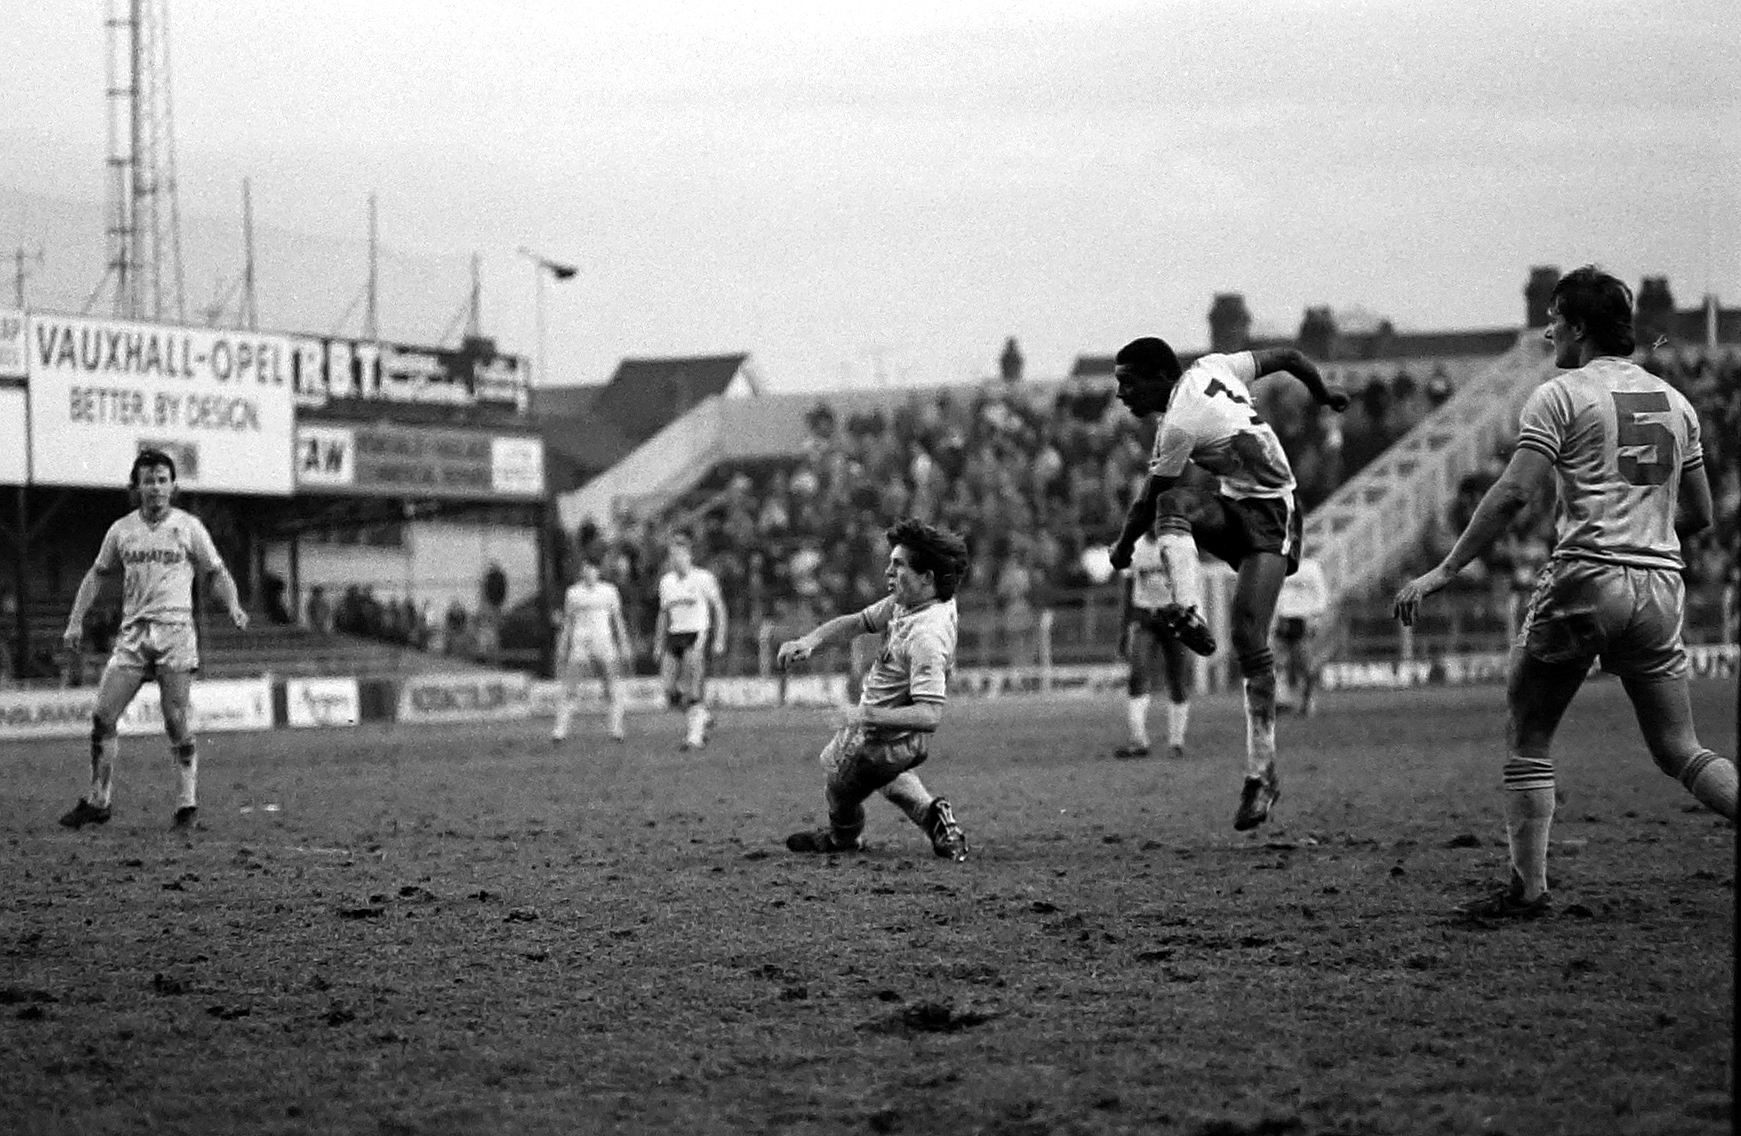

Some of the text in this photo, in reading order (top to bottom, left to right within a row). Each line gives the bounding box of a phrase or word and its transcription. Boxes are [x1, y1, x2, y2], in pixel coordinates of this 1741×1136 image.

[36, 323, 284, 386] VAUXHALL-OPEL
[71, 387, 262, 431] BETTER BY DESIGN
[1611, 391, 1676, 486] 5
